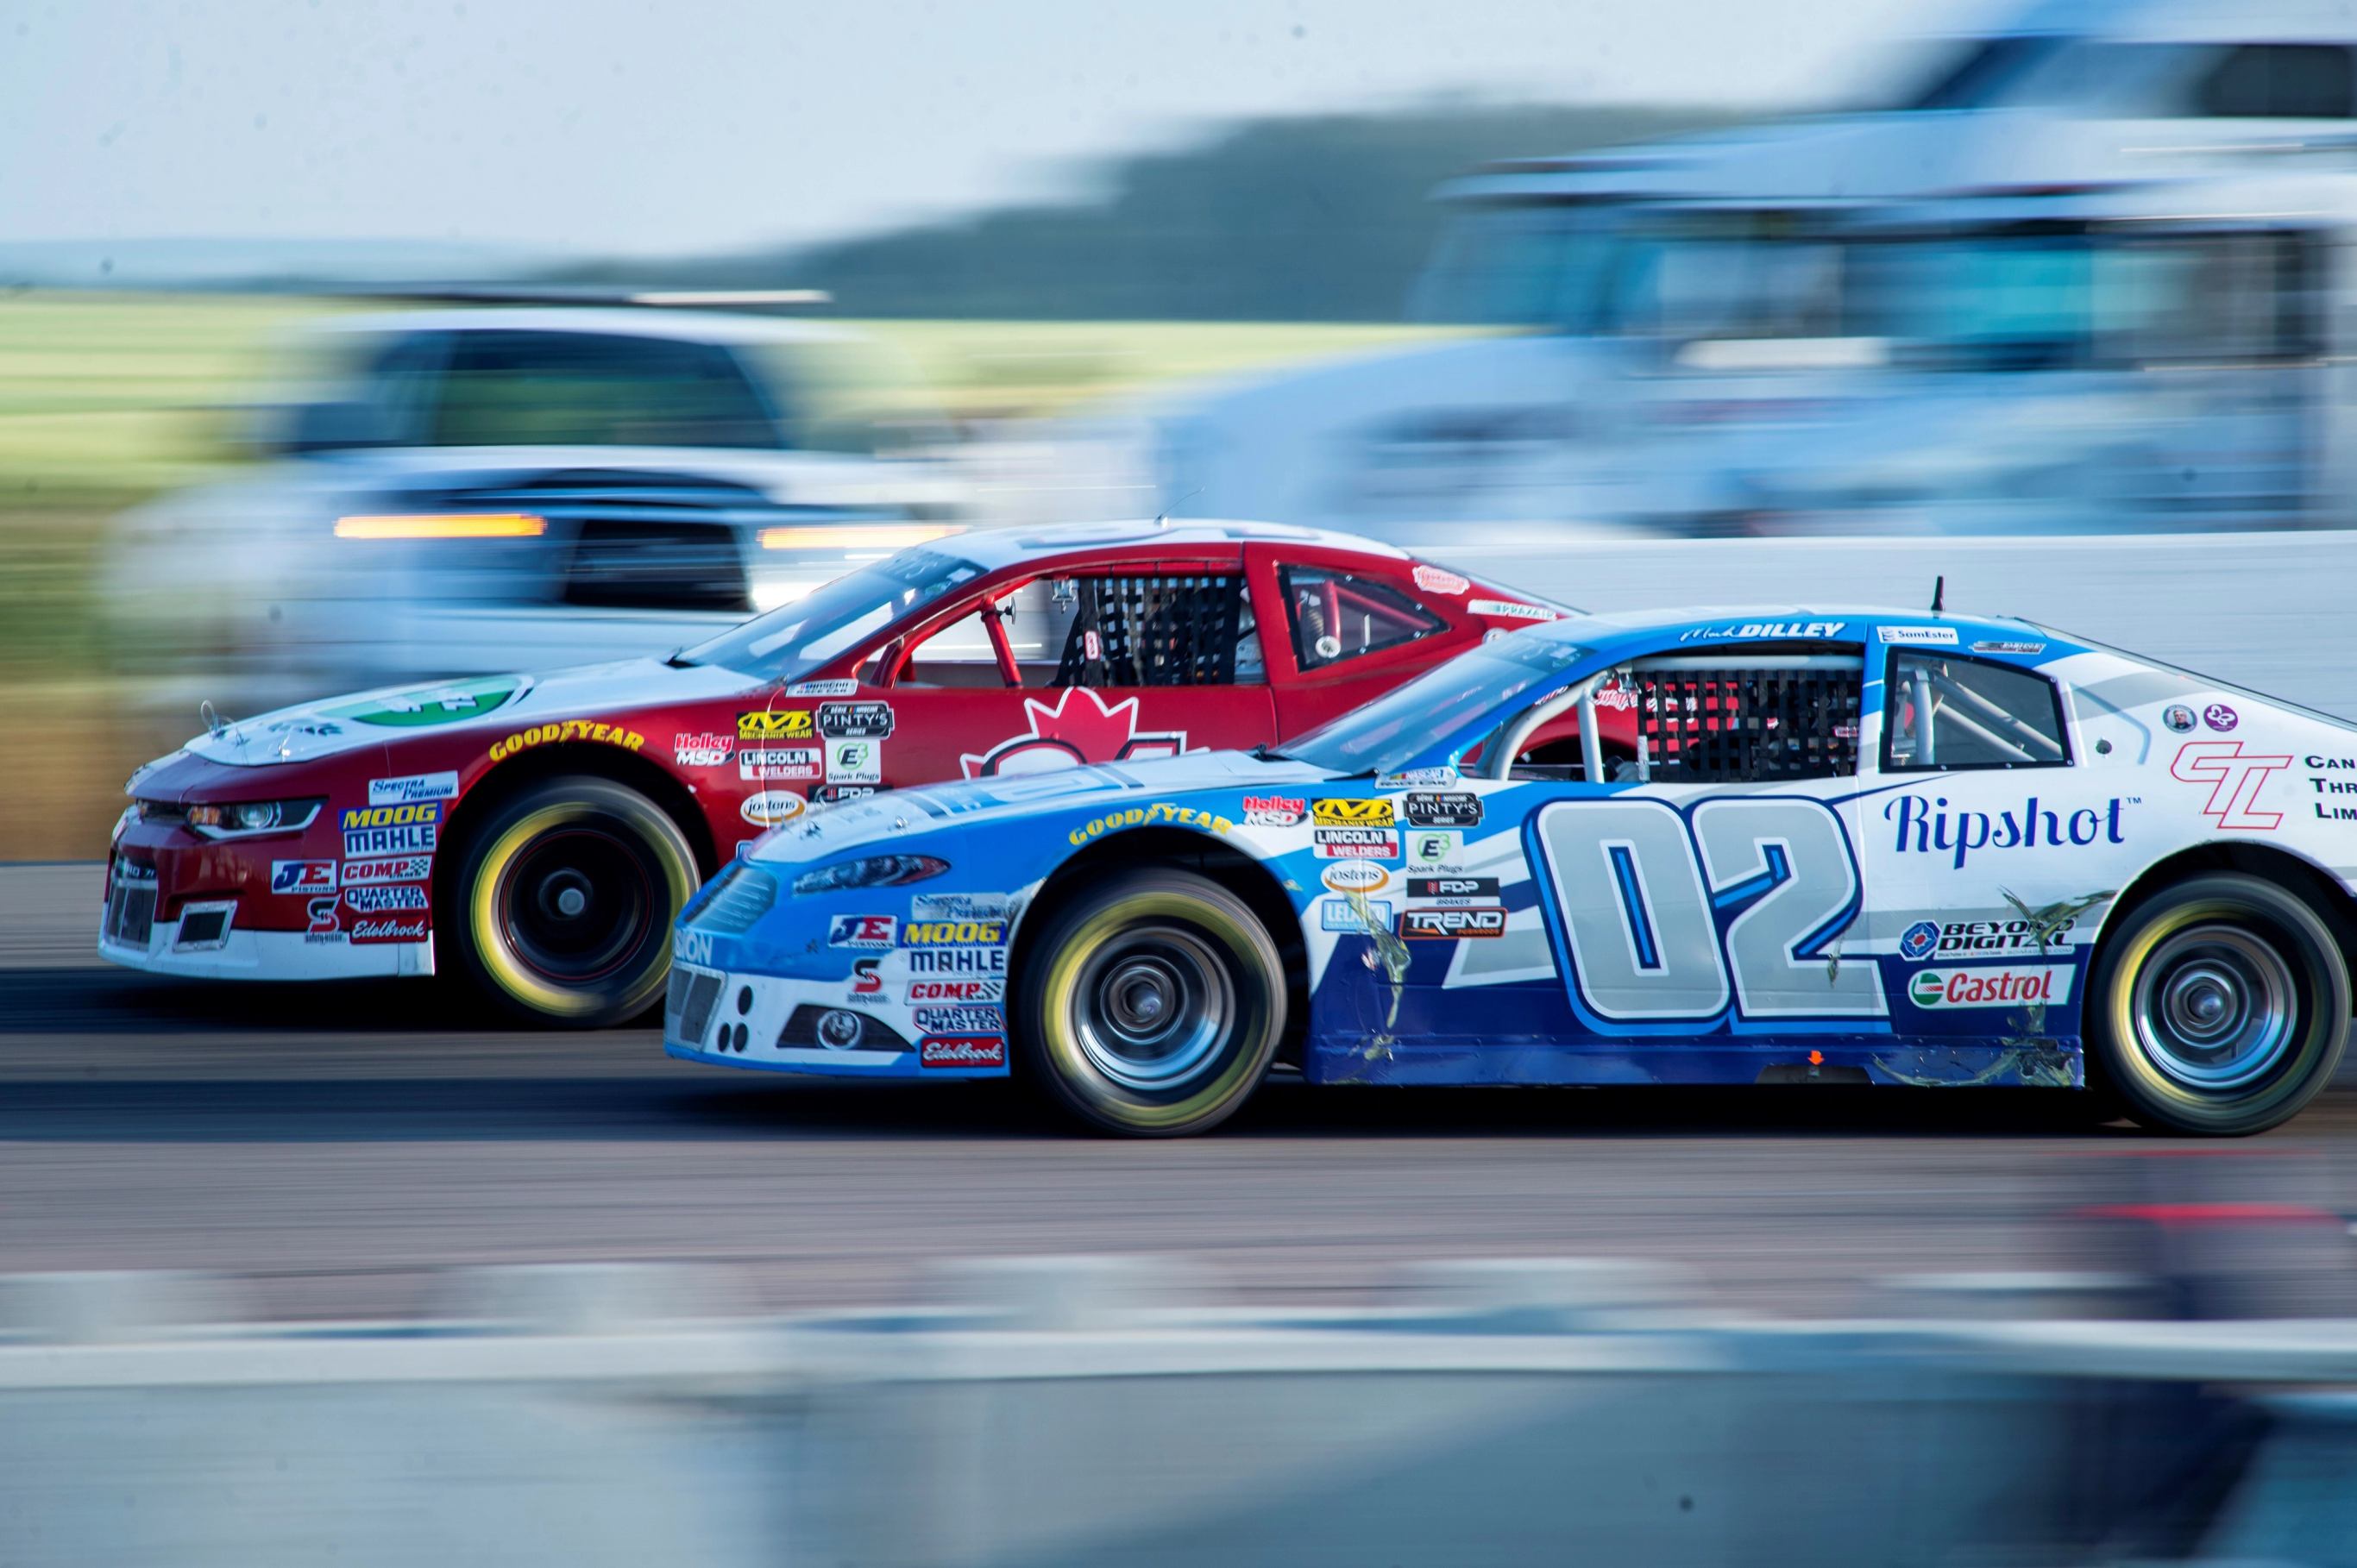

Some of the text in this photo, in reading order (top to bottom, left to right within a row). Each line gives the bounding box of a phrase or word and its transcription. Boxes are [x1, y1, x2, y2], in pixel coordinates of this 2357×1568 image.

[1737, 623, 1845, 638] DILLEY
[1898, 630, 1954, 639] SamEster
[824, 713, 888, 725] PINTY'S
[489, 720, 644, 762] GOODYEAR
[675, 732, 734, 752] Holley
[739, 730, 813, 740] MECHANIX WEAR
[676, 750, 726, 766] MSD
[745, 752, 807, 765] LINCOLN
[758, 766, 814, 776] WELDERS
[828, 772, 879, 781] Spark Plugs
[373, 779, 425, 793] SPECTRA
[402, 786, 453, 800] PREMIUM
[747, 799, 795, 816] jostens
[1243, 796, 1305, 812] Holley
[1409, 803, 1479, 814] PINTY'S
[343, 802, 437, 830] MOOG
[1069, 803, 1233, 845] GOODYEAR
[1243, 811, 1298, 826] MSD
[1367, 818, 1395, 827] WEAR
[346, 826, 434, 853] MAHLE
[1317, 831, 1384, 844] LINCOLN
[1884, 795, 2125, 869] Ripshot
[1332, 844, 1391, 856] WELDERS
[273, 863, 332, 890] JE
[344, 861, 410, 880] COMP
[1329, 866, 1380, 884] jostens
[1408, 863, 1463, 874] Spark Plugs
[1439, 881, 1480, 893] FDP
[347, 887, 421, 904] QUARTER
[360, 897, 426, 912] MASTER
[1536, 798, 1891, 1020] 02
[352, 919, 424, 939] Edelbrock
[831, 916, 892, 944] JE
[1407, 912, 1503, 935] TREND
[903, 922, 1002, 944] MOOG
[911, 950, 1003, 972] MAHLE
[910, 983, 980, 999] COMP
[1946, 970, 2052, 1003] Castrol
[917, 1007, 996, 1025] QUARTER
[932, 1019, 1001, 1032] MASTER
[923, 1042, 1003, 1062] Edelbrock
